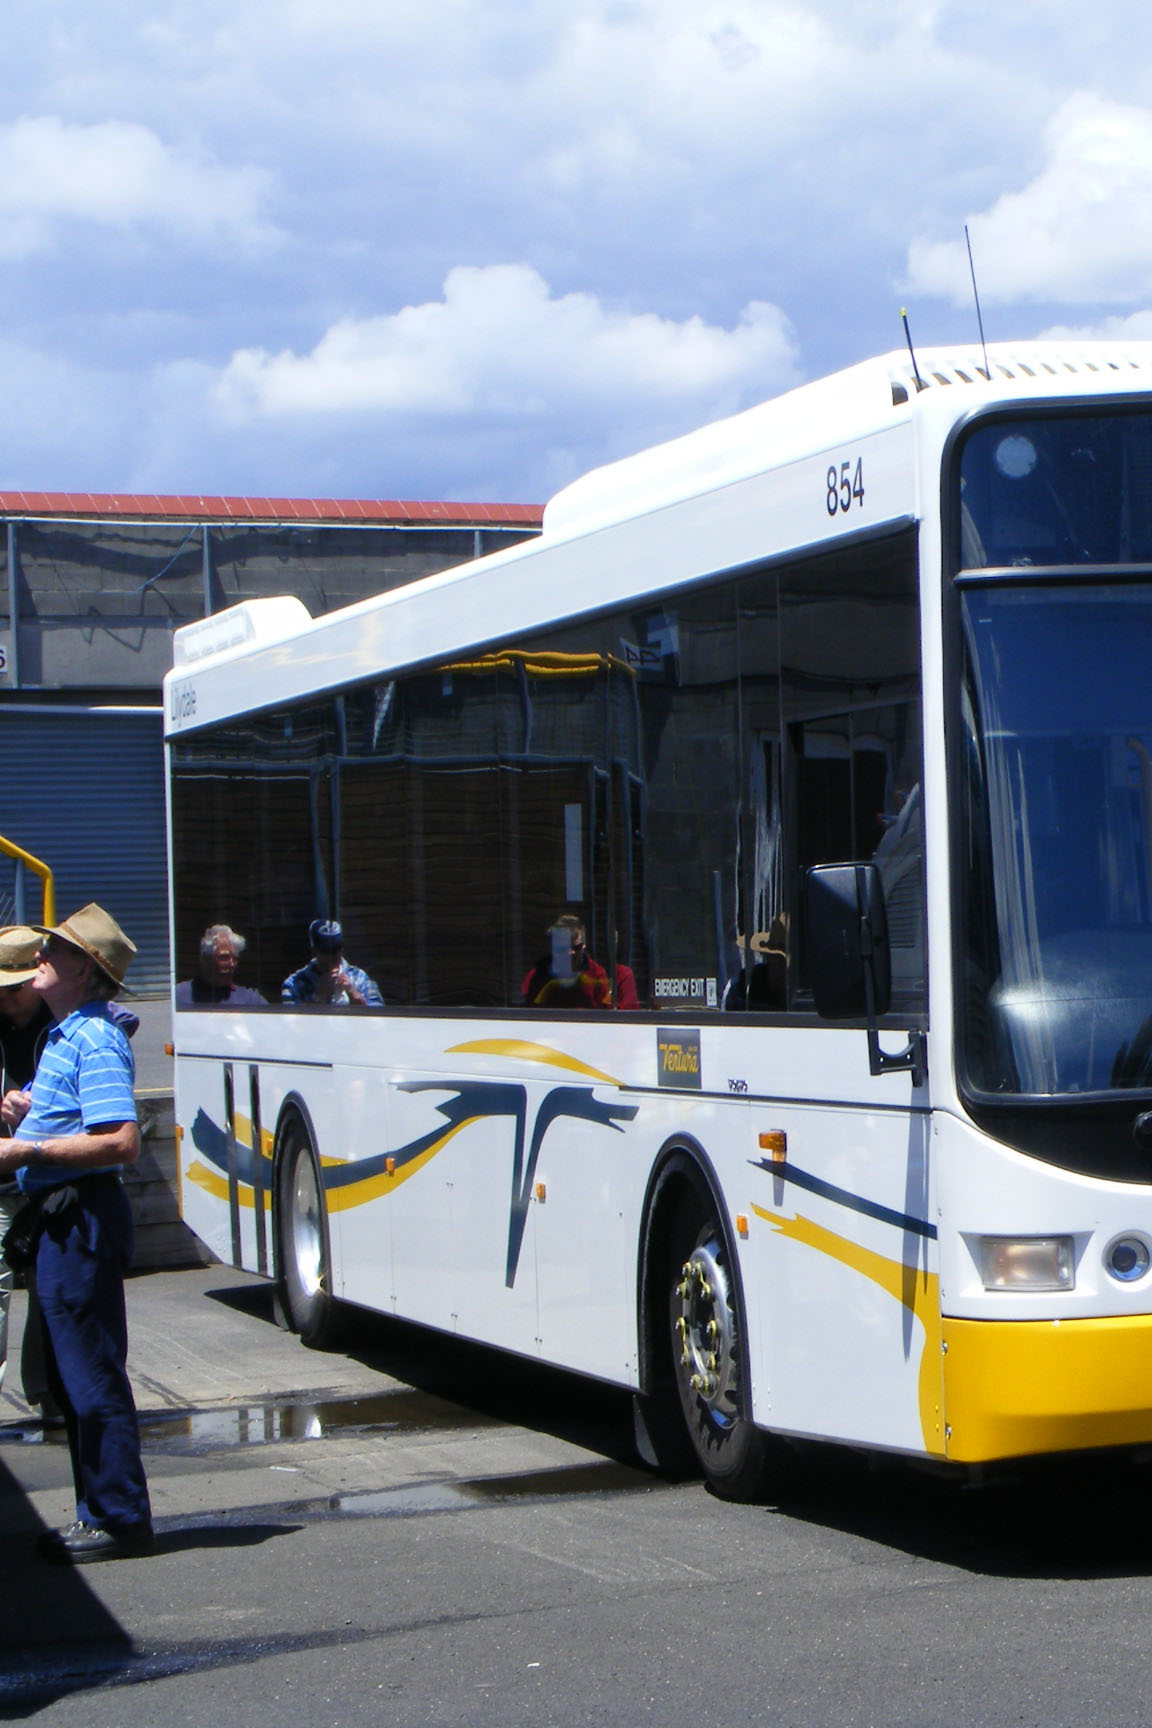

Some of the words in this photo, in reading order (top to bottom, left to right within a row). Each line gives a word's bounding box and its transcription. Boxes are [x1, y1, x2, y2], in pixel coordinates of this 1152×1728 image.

[826, 456, 865, 516] 854
[655, 978, 690, 997] EMERGENCY
[691, 978, 704, 997] EXIT
[659, 1044, 698, 1073] Ventura
